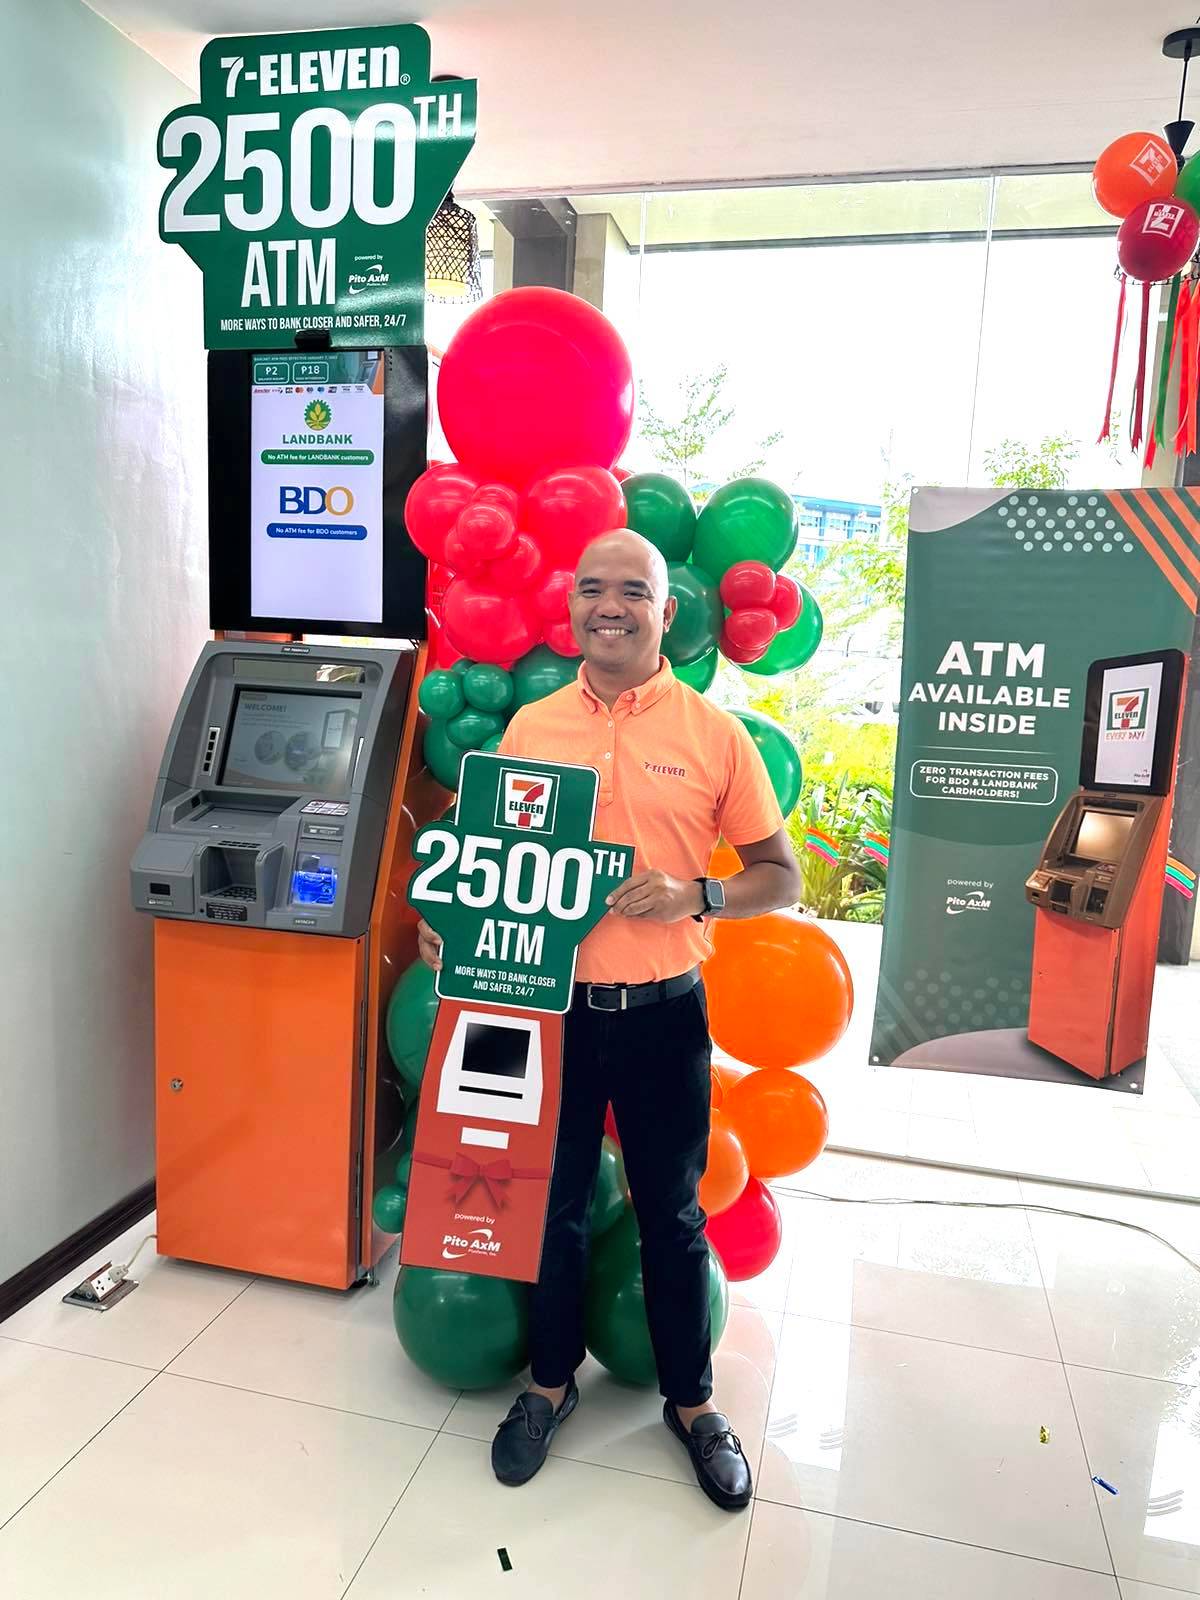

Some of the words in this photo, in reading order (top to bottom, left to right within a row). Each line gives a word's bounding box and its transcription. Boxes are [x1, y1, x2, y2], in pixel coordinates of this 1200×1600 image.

[240, 237, 337, 308] ATM
[348, 274, 367, 283] Pito
[367, 274, 389, 283] AxM
[220, 318, 243, 331] MORE
[244, 318, 267, 330] WAYS
[268, 317, 278, 329] TO
[279, 317, 301, 329] BANK
[303, 316, 334, 329] CLOSER
[335, 315, 352, 328] AND
[353, 315, 382, 329] SAFER,
[384, 314, 406, 327] 24/7
[282, 434, 353, 444] LANDBANK
[280, 486, 354, 516] BDO
[936, 641, 1046, 678] ATM
[908, 682, 1071, 709] AVAILABLE
[1116, 696, 1140, 728] 7
[938, 711, 1036, 735] INSIDE
[1106, 732, 1128, 740] EVERY
[1128, 730, 1145, 740] DAY!
[919, 766, 946, 775] ZERO
[949, 768, 1021, 779] TRANSACTION
[1024, 772, 1049, 780] FEES
[925, 776, 946, 784] FOR
[948, 777, 970, 786] BDO
[972, 778, 979, 786] &
[982, 779, 1038, 790] LANDBANK
[941, 786, 1020, 798] CARDHOLDERS!
[512, 778, 544, 827] 7
[947, 879, 982, 887] powered
[984, 880, 994, 889] by
[946, 896, 966, 906] Pito
[967, 899, 991, 908] AxM
[474, 918, 546, 965] ATM
[454, 965, 476, 977] MORE
[476, 967, 497, 980] WAYS
[498, 970, 507, 981] TO
[508, 972, 528, 984] BANK
[528, 975, 556, 988] CLOSER
[473, 980, 488, 990] AND
[489, 982, 514, 995] SAFER,
[515, 985, 535, 997] 24/7
[454, 1214, 485, 1223] powered
[486, 1216, 496, 1225] by
[443, 1235, 469, 1248] Pito
[470, 1239, 501, 1252] AxM
